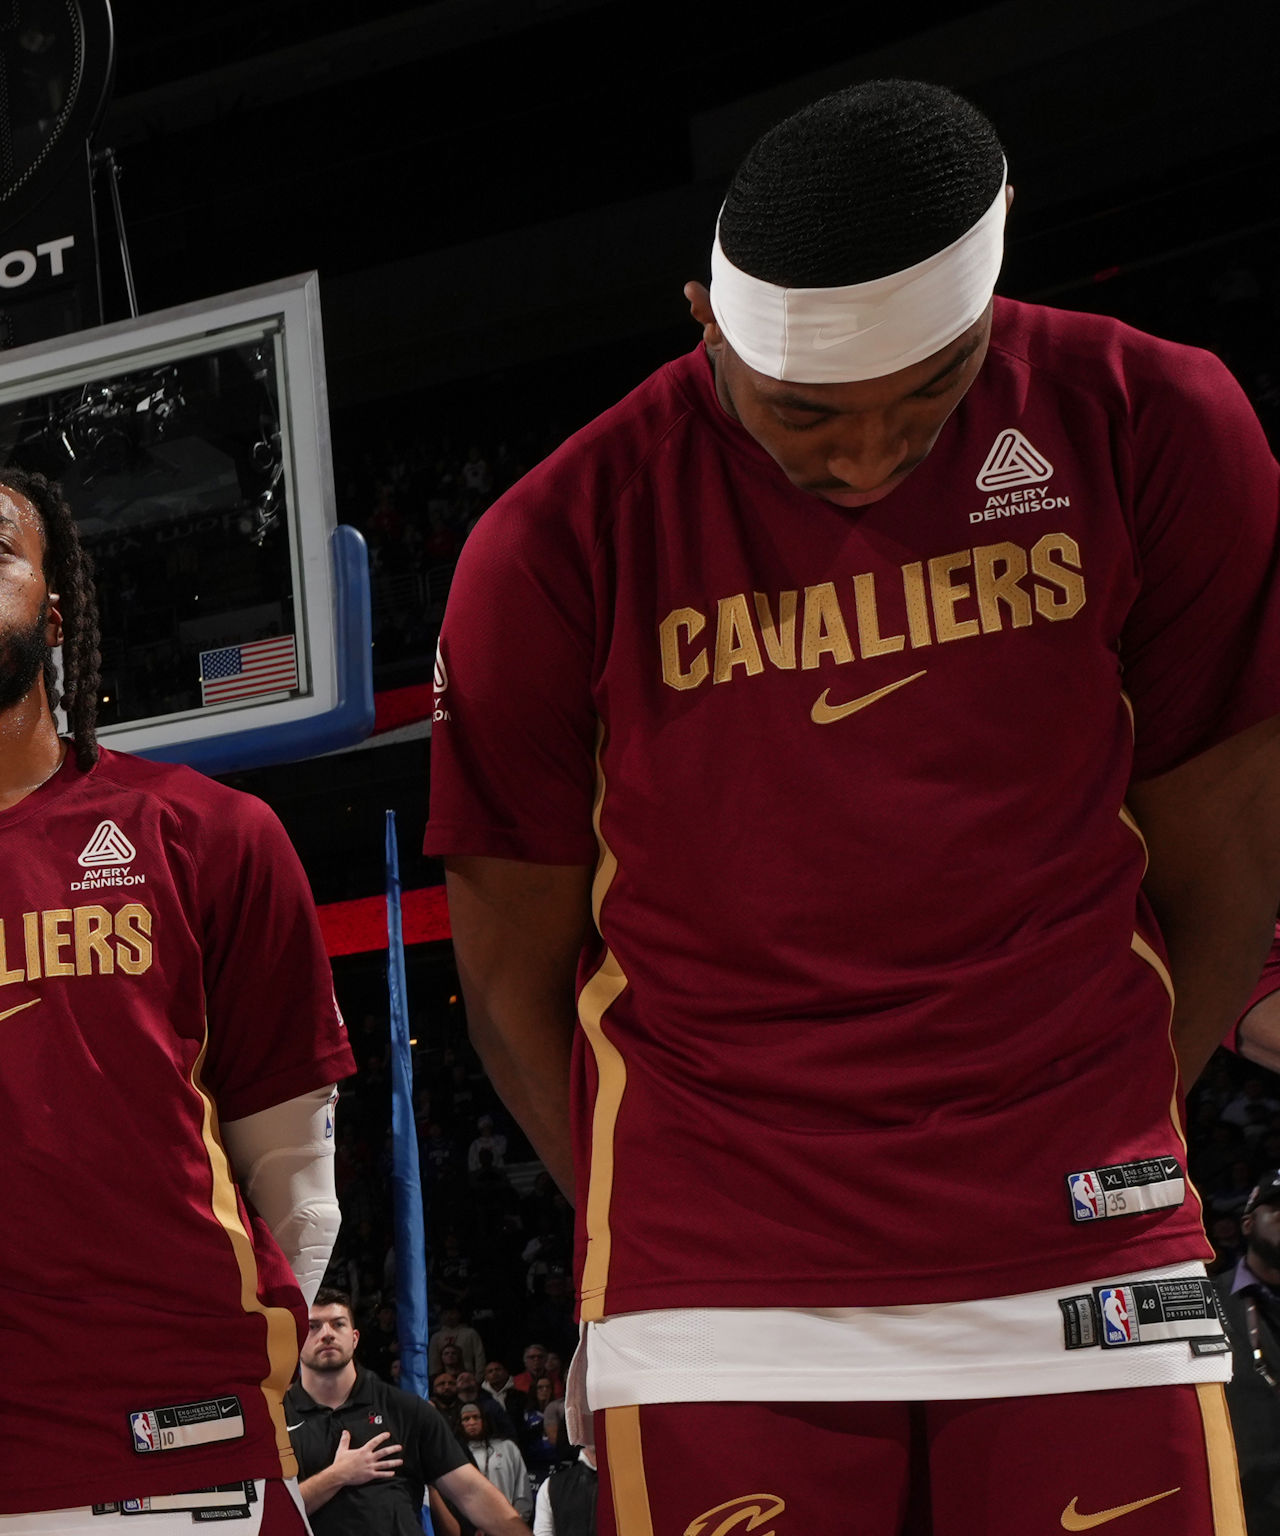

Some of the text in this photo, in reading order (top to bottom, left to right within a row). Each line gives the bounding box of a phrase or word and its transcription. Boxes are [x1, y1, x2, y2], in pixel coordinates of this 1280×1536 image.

[984, 486, 1050, 509] AVERY
[968, 496, 1071, 524] DENNISON
[658, 532, 1087, 692] CAVALIERS
[83, 866, 131, 880] AVERY
[70, 874, 146, 891] DENNISON
[1105, 1175, 1122, 1185] XL
[1108, 1191, 1127, 1212] 35
[1077, 1208, 1091, 1218] NBA
[1142, 1299, 1156, 1310] 48
[1109, 1330, 1123, 1342] NBA
[163, 1415, 171, 1424] L
